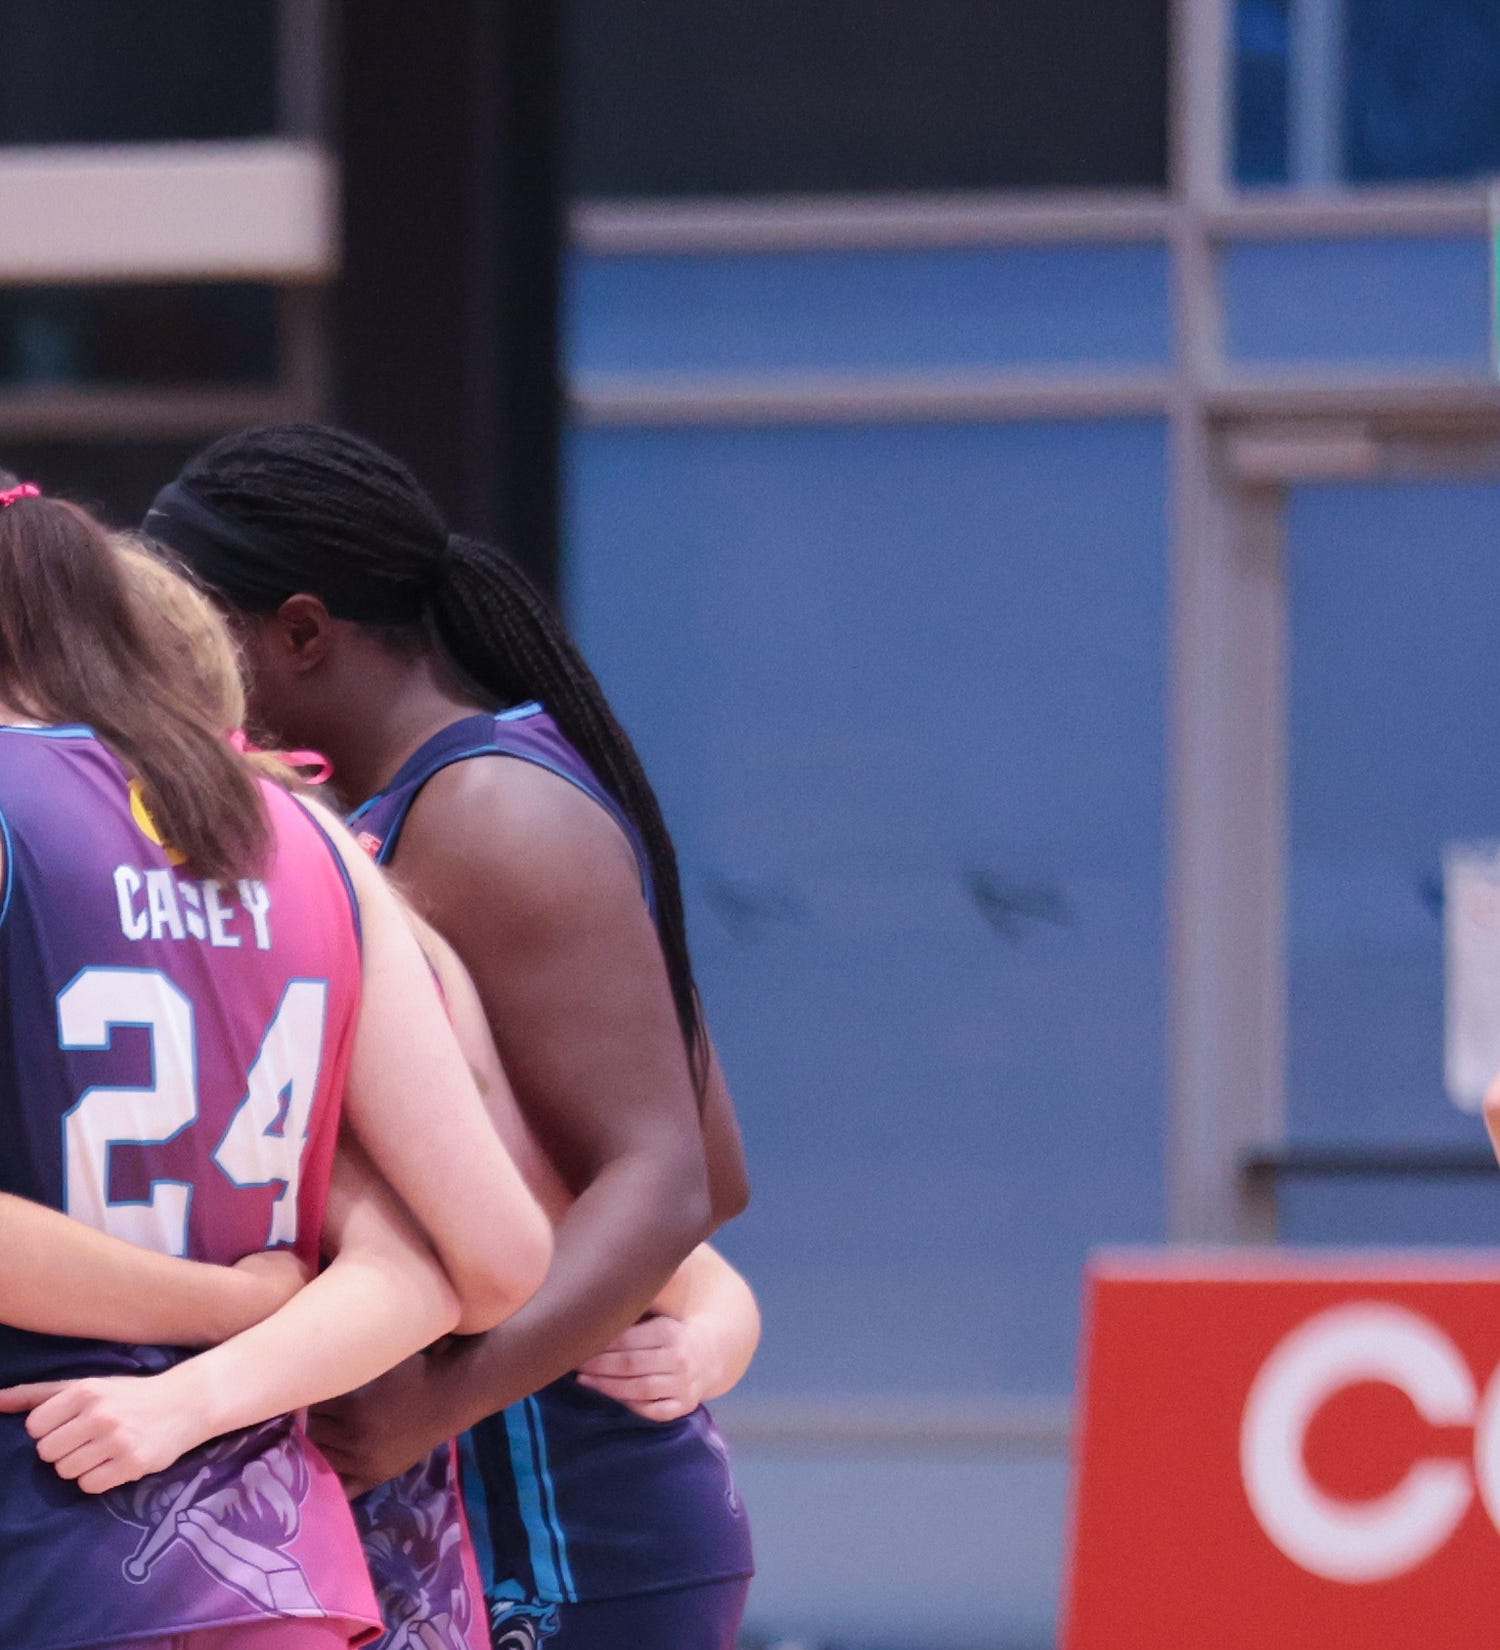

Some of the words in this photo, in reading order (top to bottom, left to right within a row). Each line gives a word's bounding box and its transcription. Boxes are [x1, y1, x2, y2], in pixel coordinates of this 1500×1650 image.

[113, 865, 272, 951] CASEY
[56, 965, 330, 1258] 24
[1239, 1300, 1500, 1586] C
